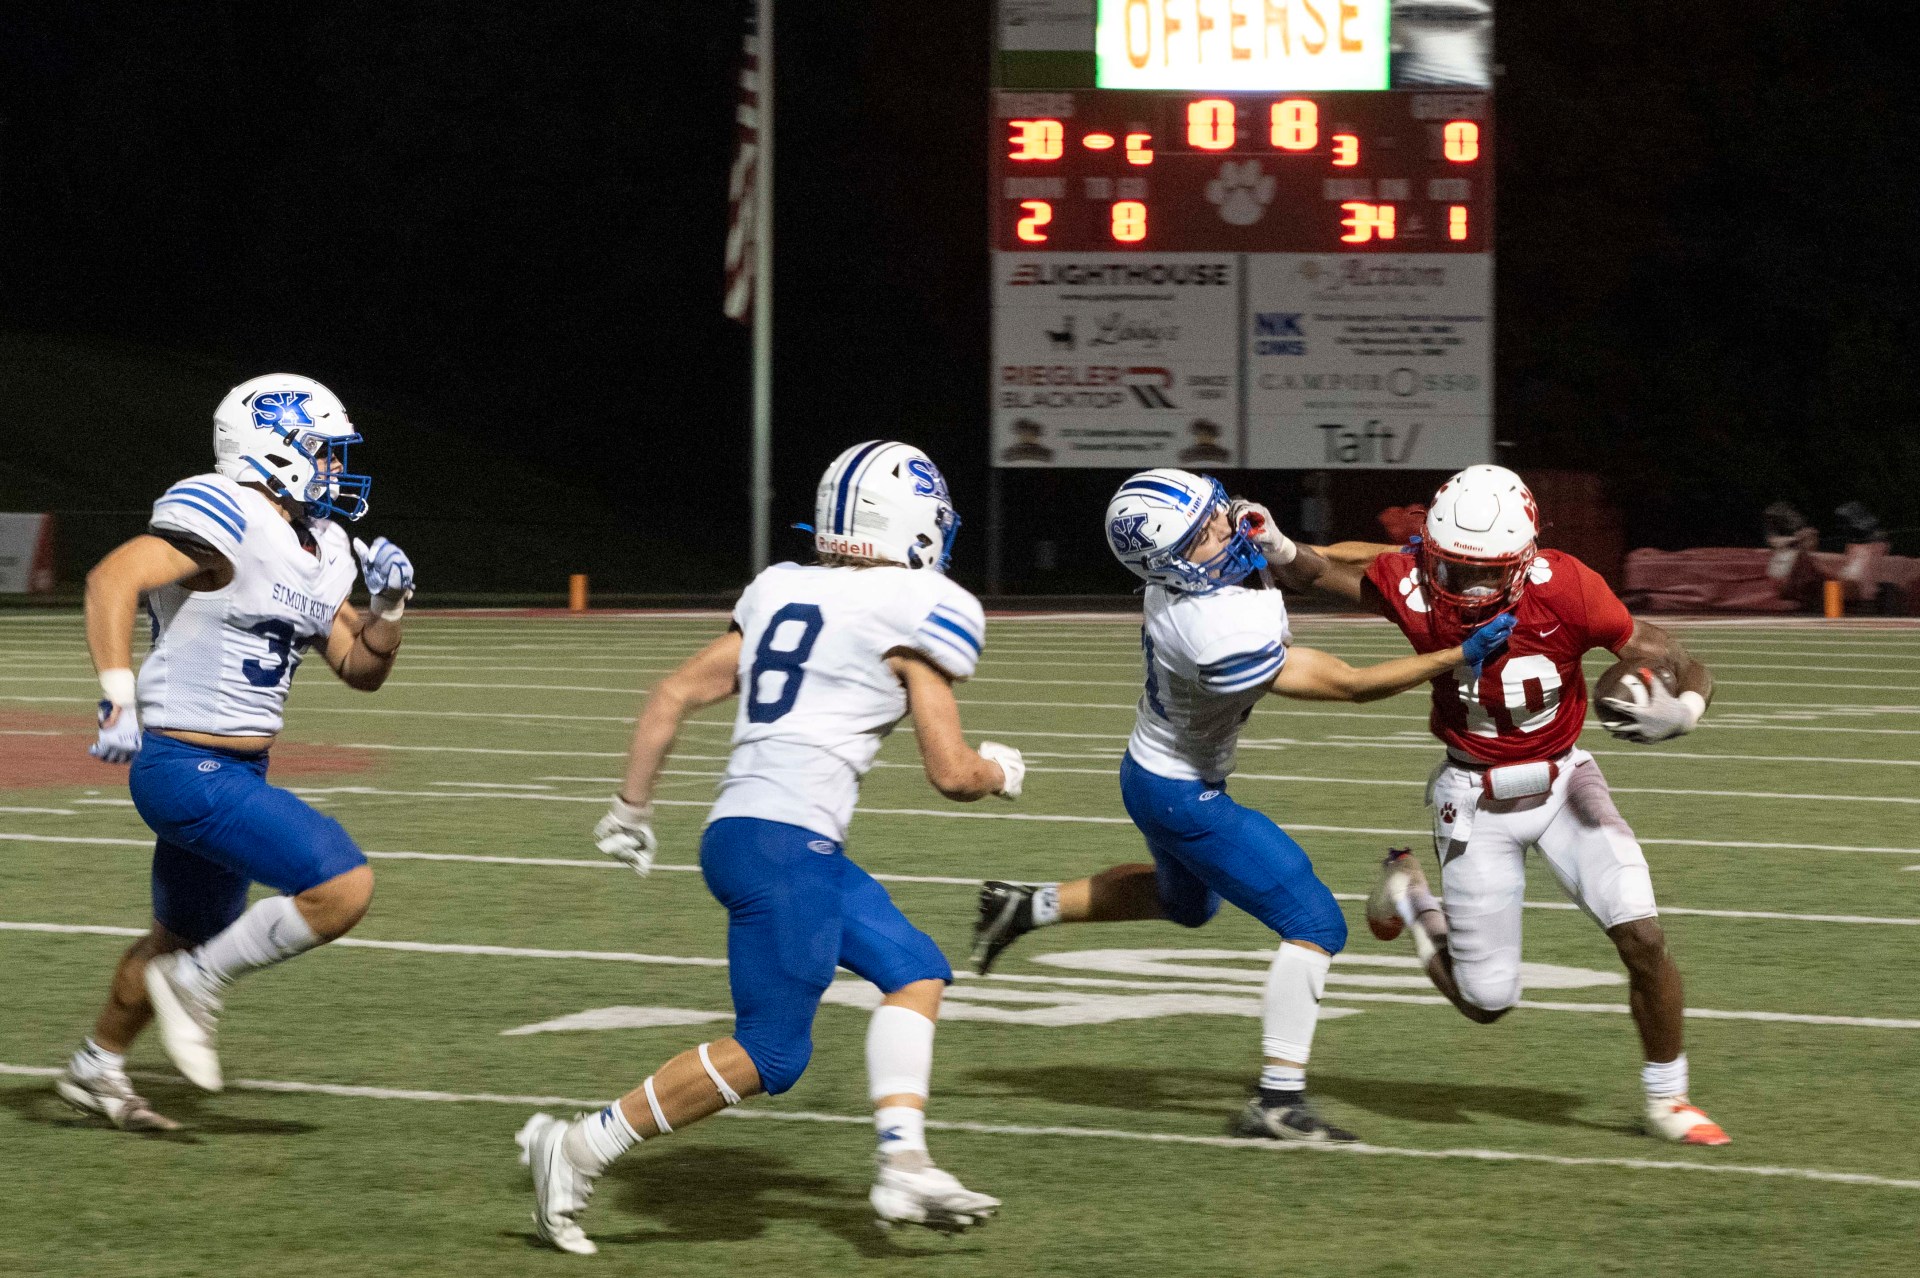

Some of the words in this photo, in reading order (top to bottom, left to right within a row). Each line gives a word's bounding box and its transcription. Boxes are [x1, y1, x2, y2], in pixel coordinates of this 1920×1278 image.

[1008, 120, 1064, 160] 30
[1331, 134, 1359, 166] 3
[1443, 121, 1479, 162] 0
[1017, 200, 1053, 242] 2
[1111, 200, 1147, 242] 8
[1340, 201, 1396, 243] 34
[1448, 205, 1468, 241] 1
[1032, 263, 1230, 286] LIGHTHOUSE
[251, 390, 316, 430] SK
[817, 536, 875, 557] Riddell
[1108, 512, 1158, 556] SK
[272, 582, 308, 614] SIMON
[747, 602, 825, 724] 8
